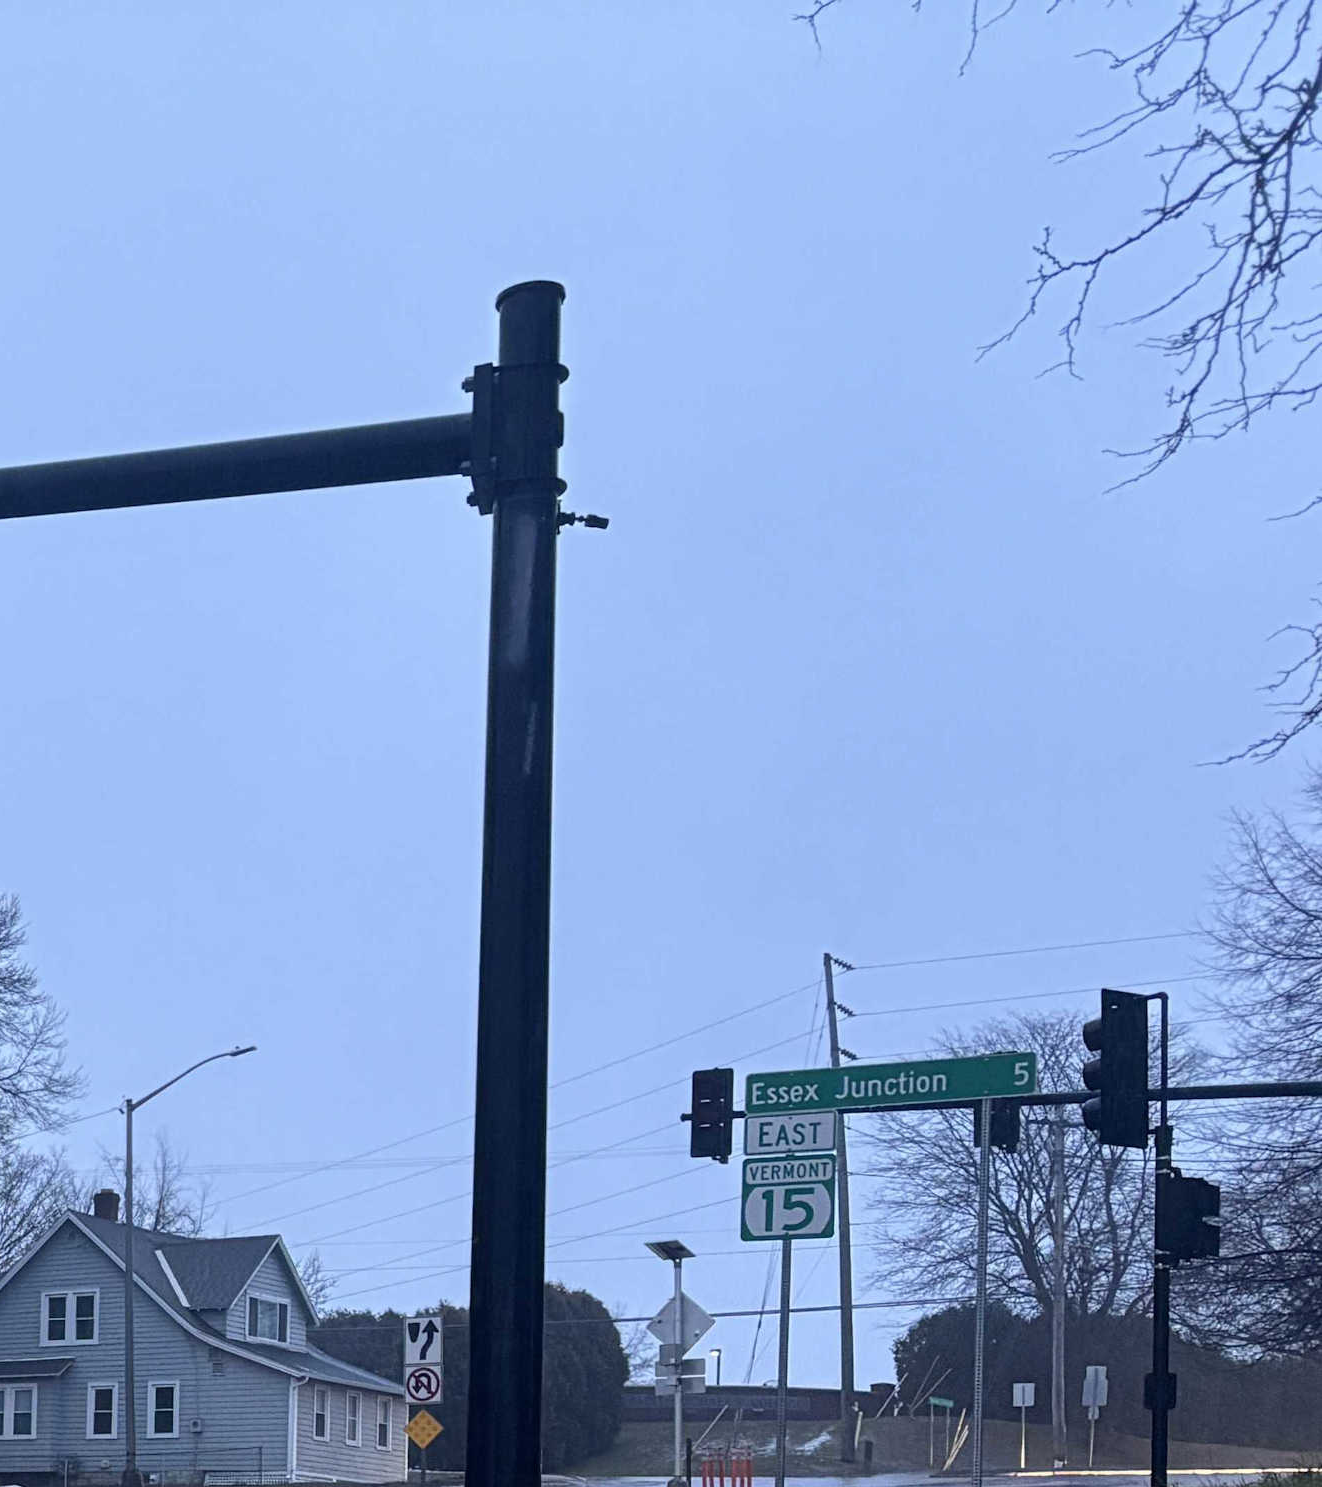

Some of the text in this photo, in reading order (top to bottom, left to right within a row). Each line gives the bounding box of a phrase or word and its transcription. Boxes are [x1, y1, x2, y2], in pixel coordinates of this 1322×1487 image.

[751, 1061, 1030, 1105] Essex Junction 5
[758, 1121, 822, 1147] EAST
[749, 1161, 831, 1181] VERMONT
[761, 1187, 815, 1232] 15
